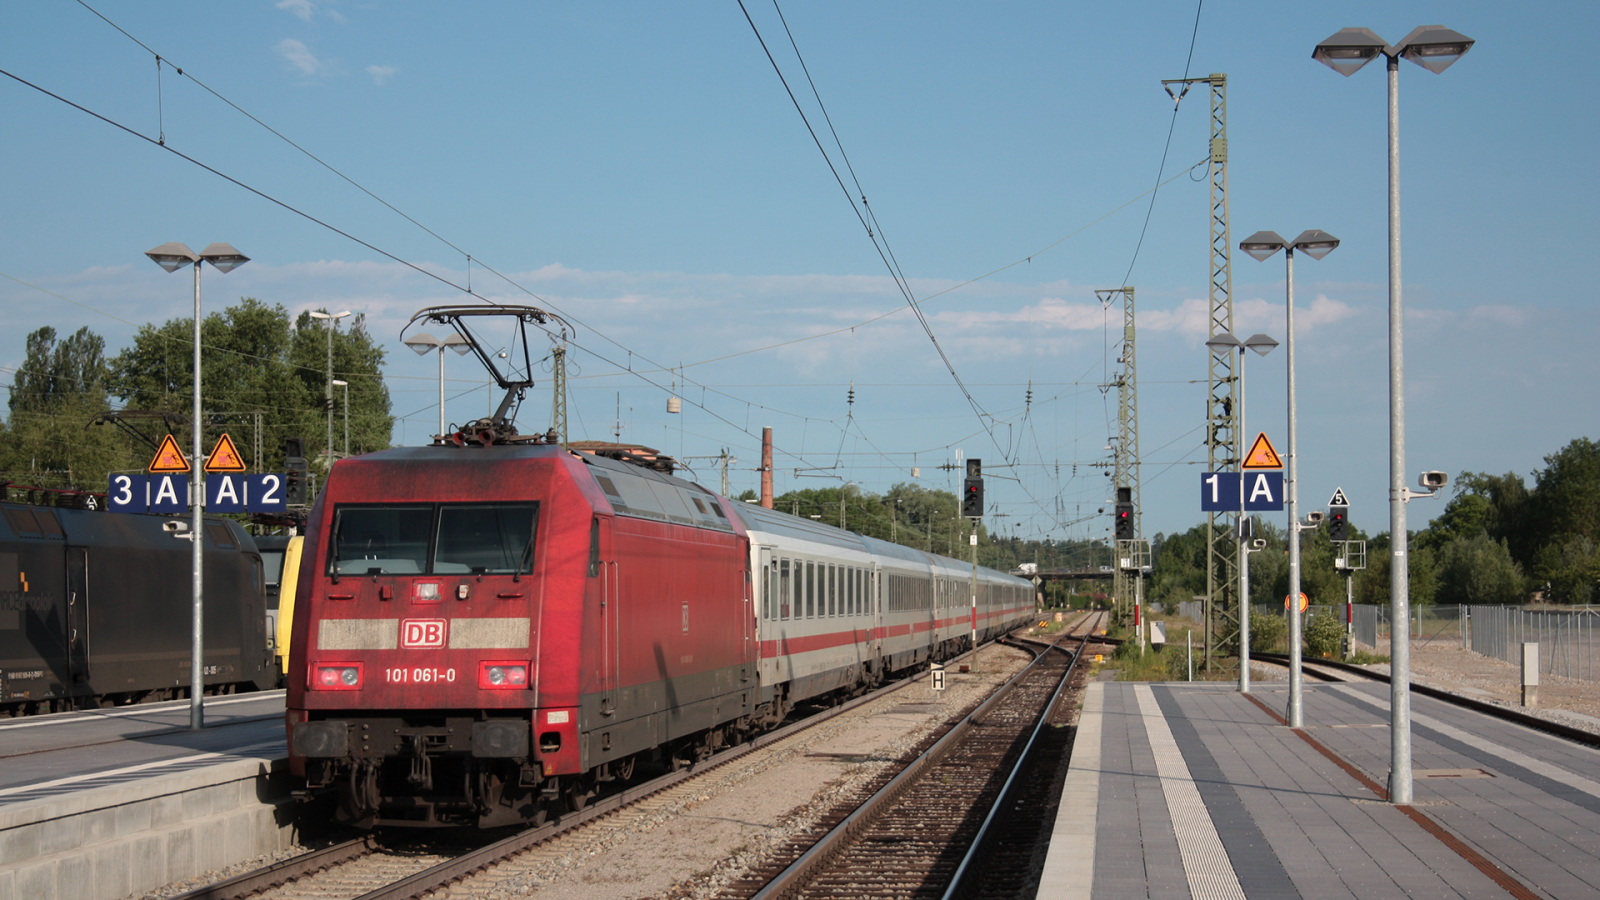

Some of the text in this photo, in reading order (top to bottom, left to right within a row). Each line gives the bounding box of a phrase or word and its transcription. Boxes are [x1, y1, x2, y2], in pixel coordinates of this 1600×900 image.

[113, 475, 178, 505] 3 A
[215, 474, 280, 504] A 2
[1205, 474, 1273, 503] 1 A
[1335, 493, 1343, 505] 5
[407, 624, 440, 643] DB
[385, 668, 456, 682] 101 061-0
[933, 672, 943, 688] H
